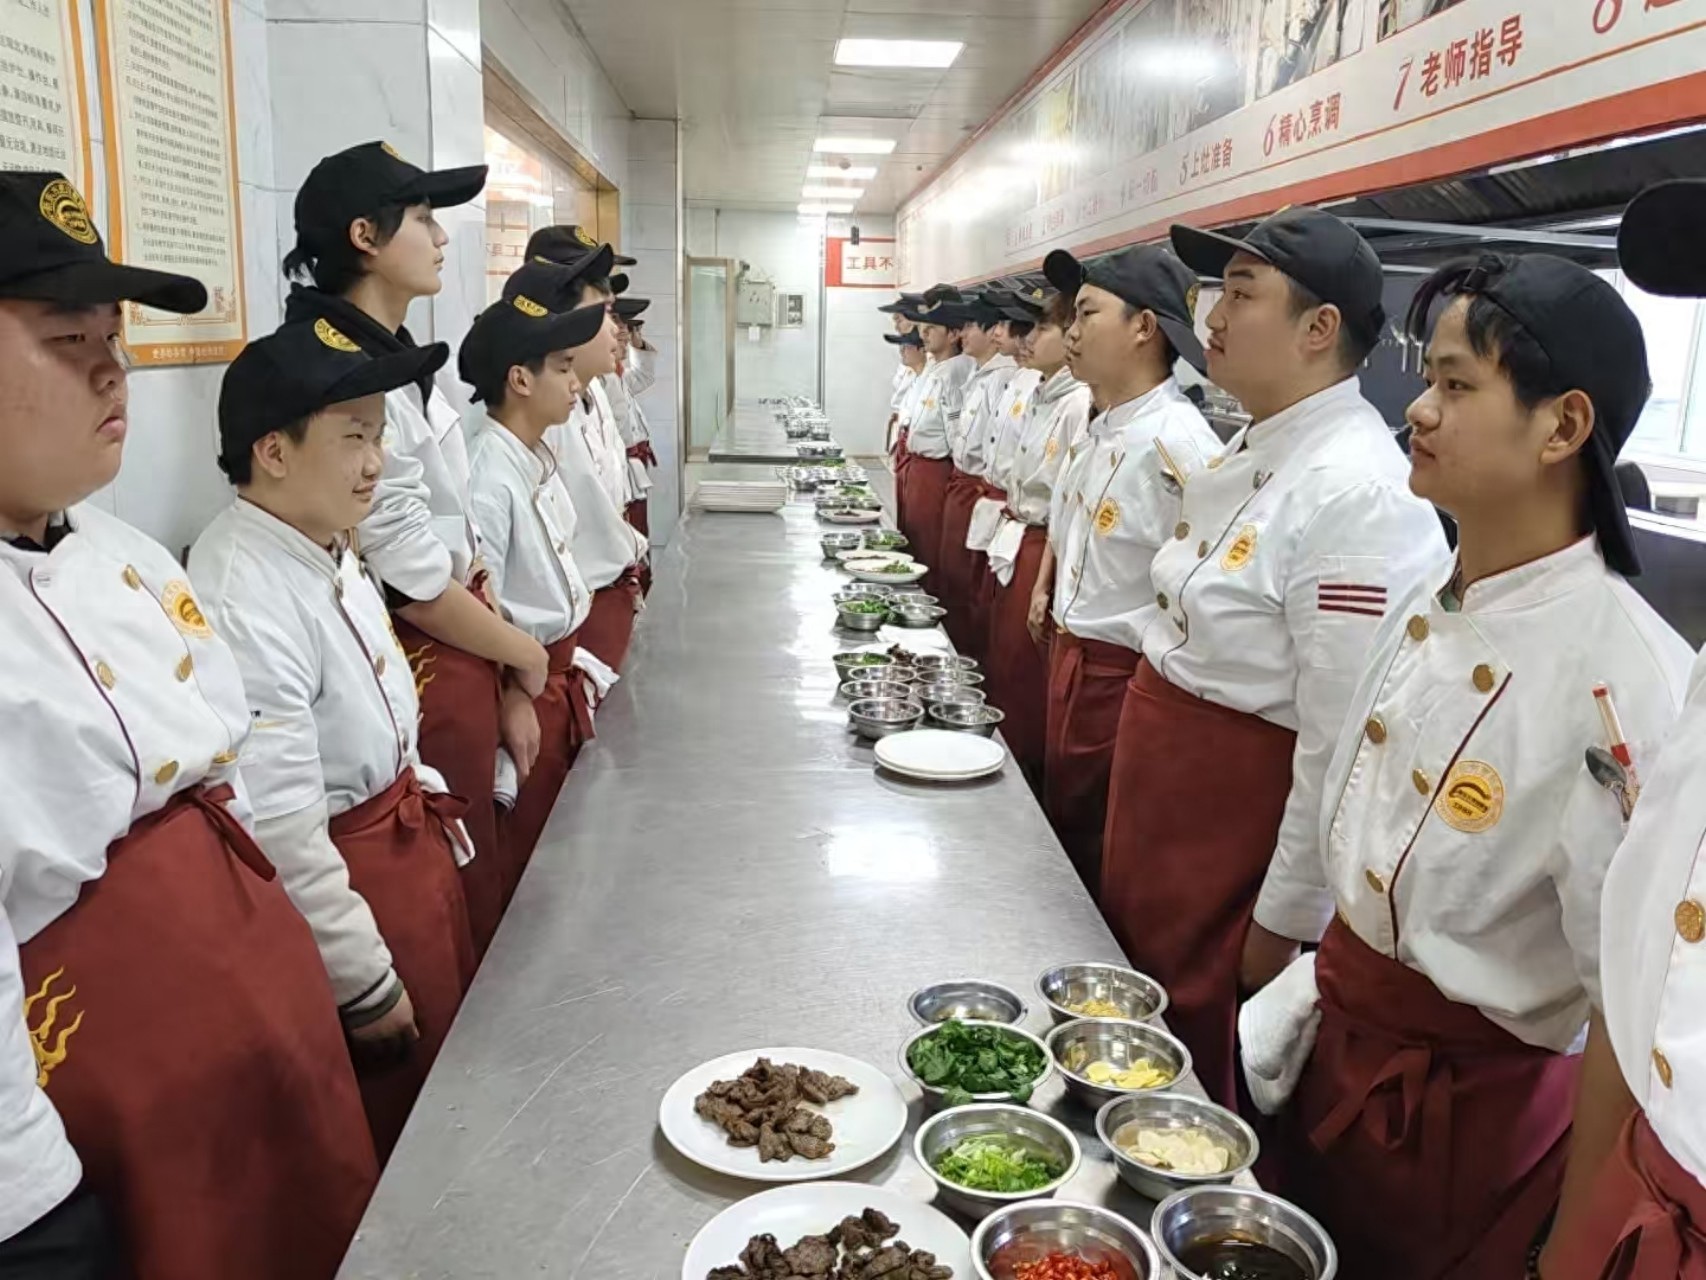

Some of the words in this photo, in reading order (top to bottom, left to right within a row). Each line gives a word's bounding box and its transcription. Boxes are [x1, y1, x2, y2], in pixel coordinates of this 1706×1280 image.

[1393, 57, 1413, 110] 7
[1420, 13, 1523, 97] 老师指导
[1263, 113, 1277, 157] 6
[1278, 91, 1341, 147] 精心烹调
[1179, 152, 1189, 185] 5
[846, 256, 894, 271] 工具不
